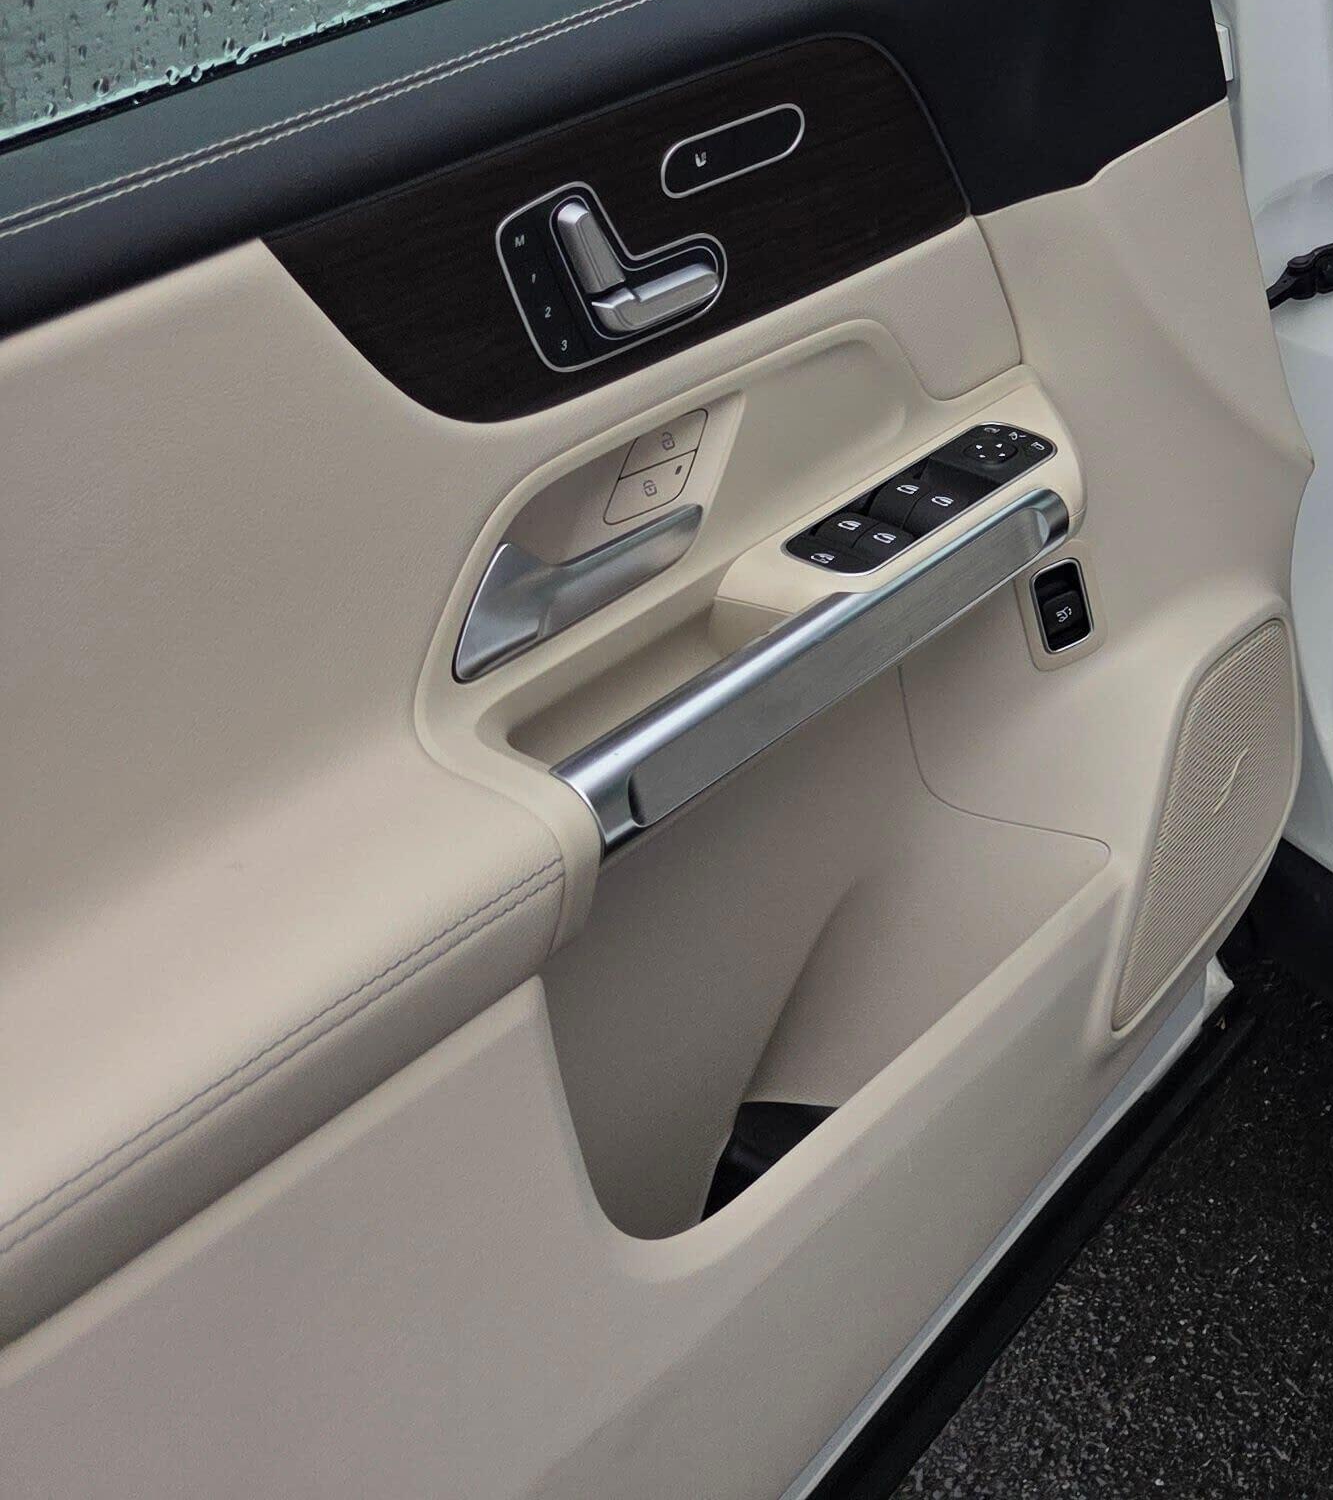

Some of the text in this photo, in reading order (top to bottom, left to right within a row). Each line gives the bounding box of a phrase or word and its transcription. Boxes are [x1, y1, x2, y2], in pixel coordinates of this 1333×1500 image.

[515, 235, 525, 248] M
[545, 306, 552, 318] 2
[561, 340, 568, 351] 3
